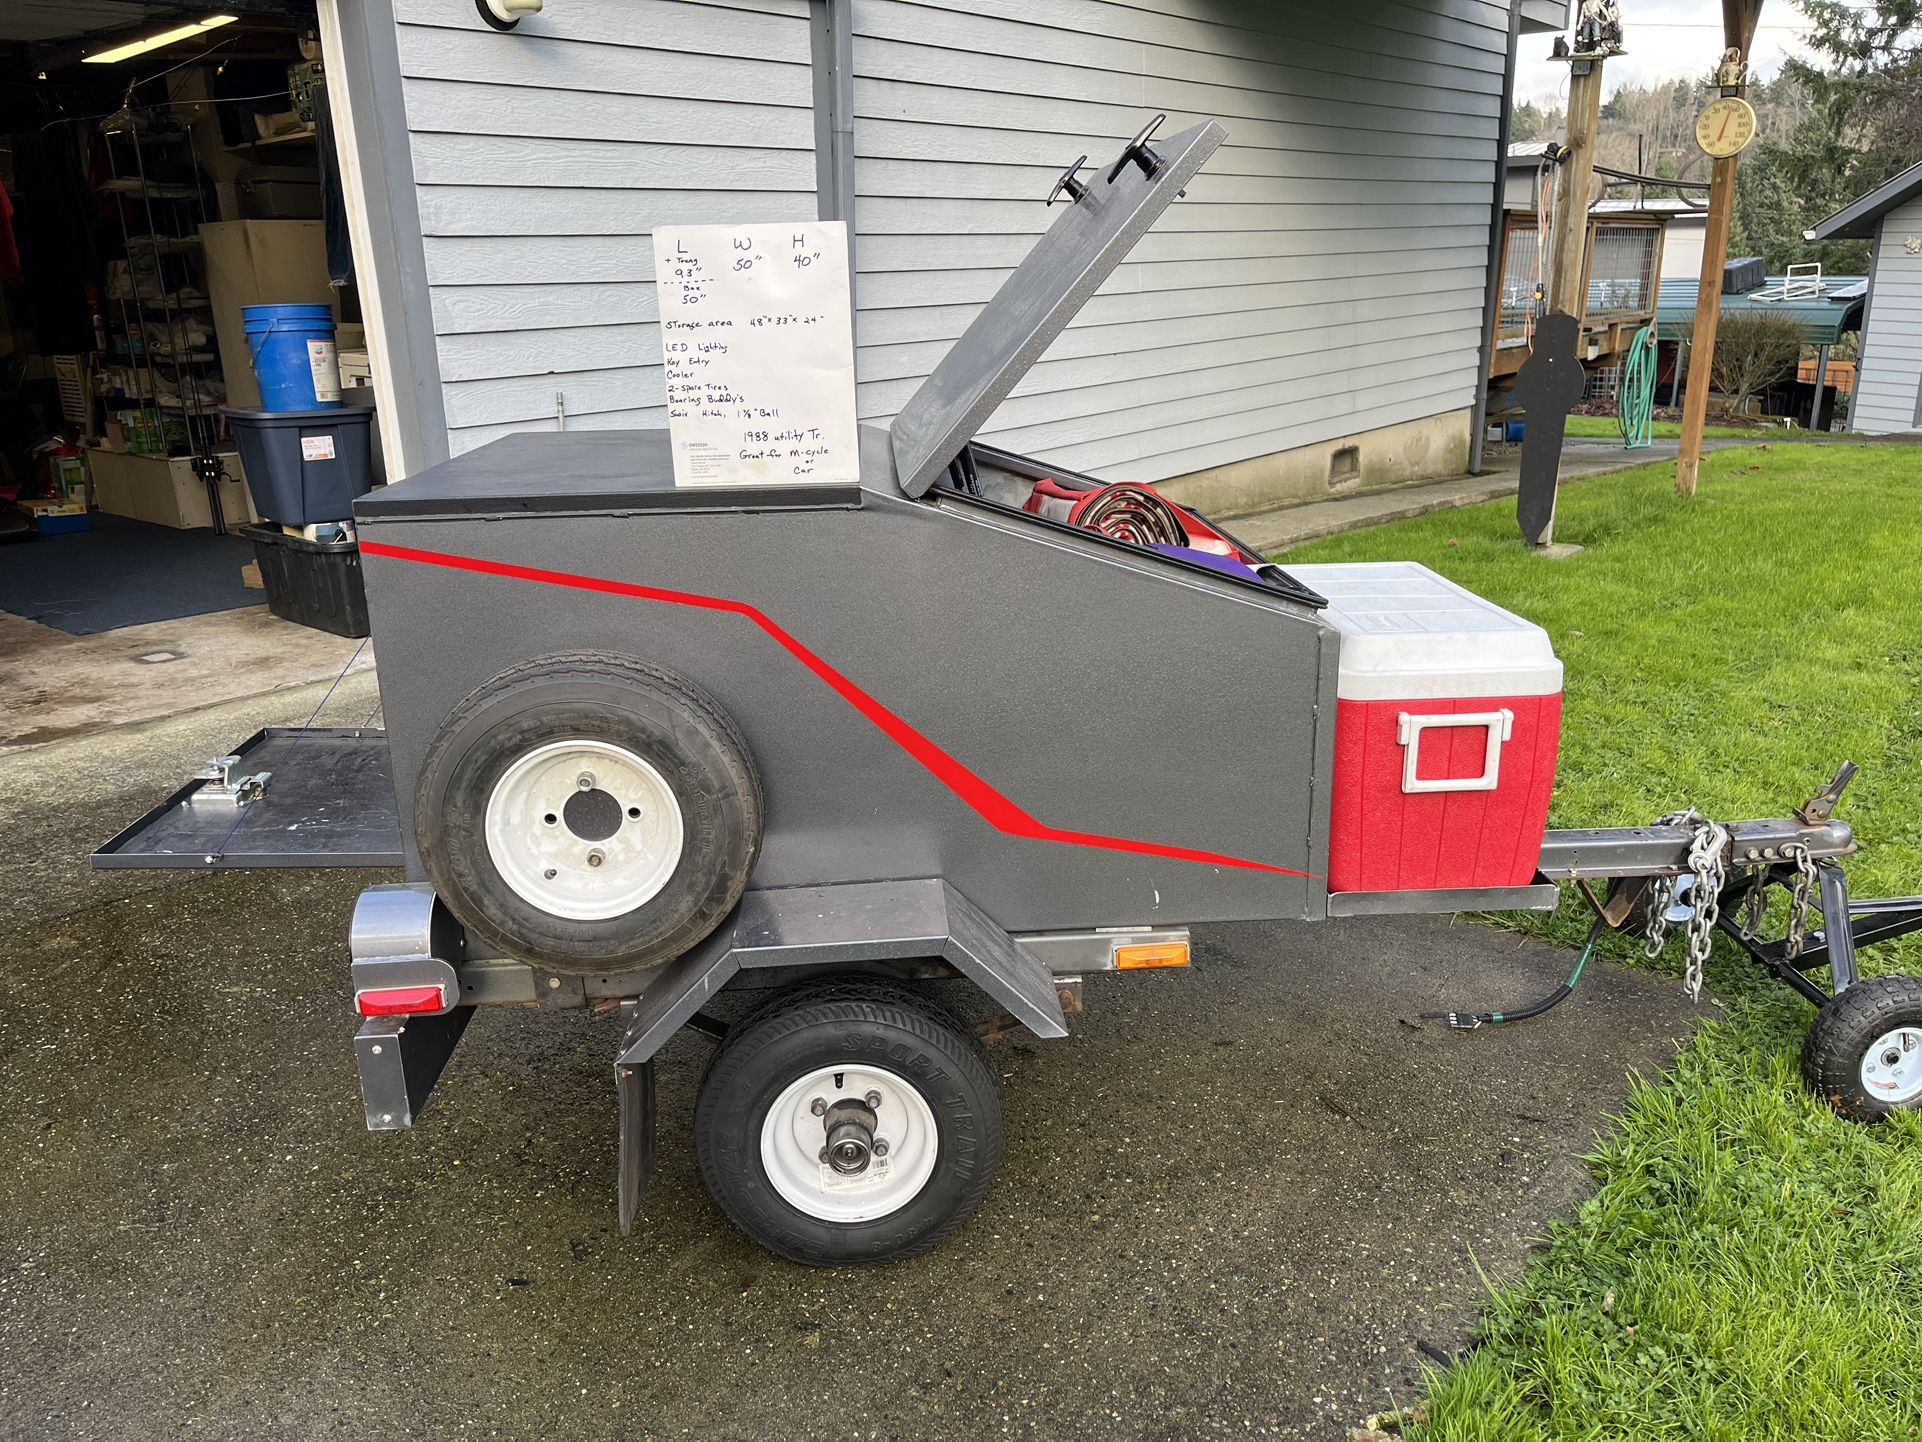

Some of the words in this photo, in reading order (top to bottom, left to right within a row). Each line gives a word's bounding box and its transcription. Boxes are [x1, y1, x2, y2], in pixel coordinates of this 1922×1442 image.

[677, 239, 688, 254] L
[733, 237, 752, 251] W
[792, 233, 804, 249] H
[732, 254, 763, 272] 50"
[793, 252, 821, 269] 40"
[674, 266, 702, 279] 93"
[683, 284, 701, 292] Box
[681, 293, 707, 305] 50"
[665, 342, 688, 353] LED
[697, 341, 728, 354] Lighting
[667, 357, 680, 368] Key
[688, 357, 710, 367] Entry
[666, 369, 694, 380] Cooler
[704, 383, 729, 391] Tires
[669, 394, 702, 407] Bearing
[759, 408, 779, 418] Ball
[743, 430, 769, 443] 1988
[739, 449, 765, 460] Great
[766, 448, 782, 458] for
[793, 465, 815, 475] Car
[841, 1033, 952, 1083] SPORT
